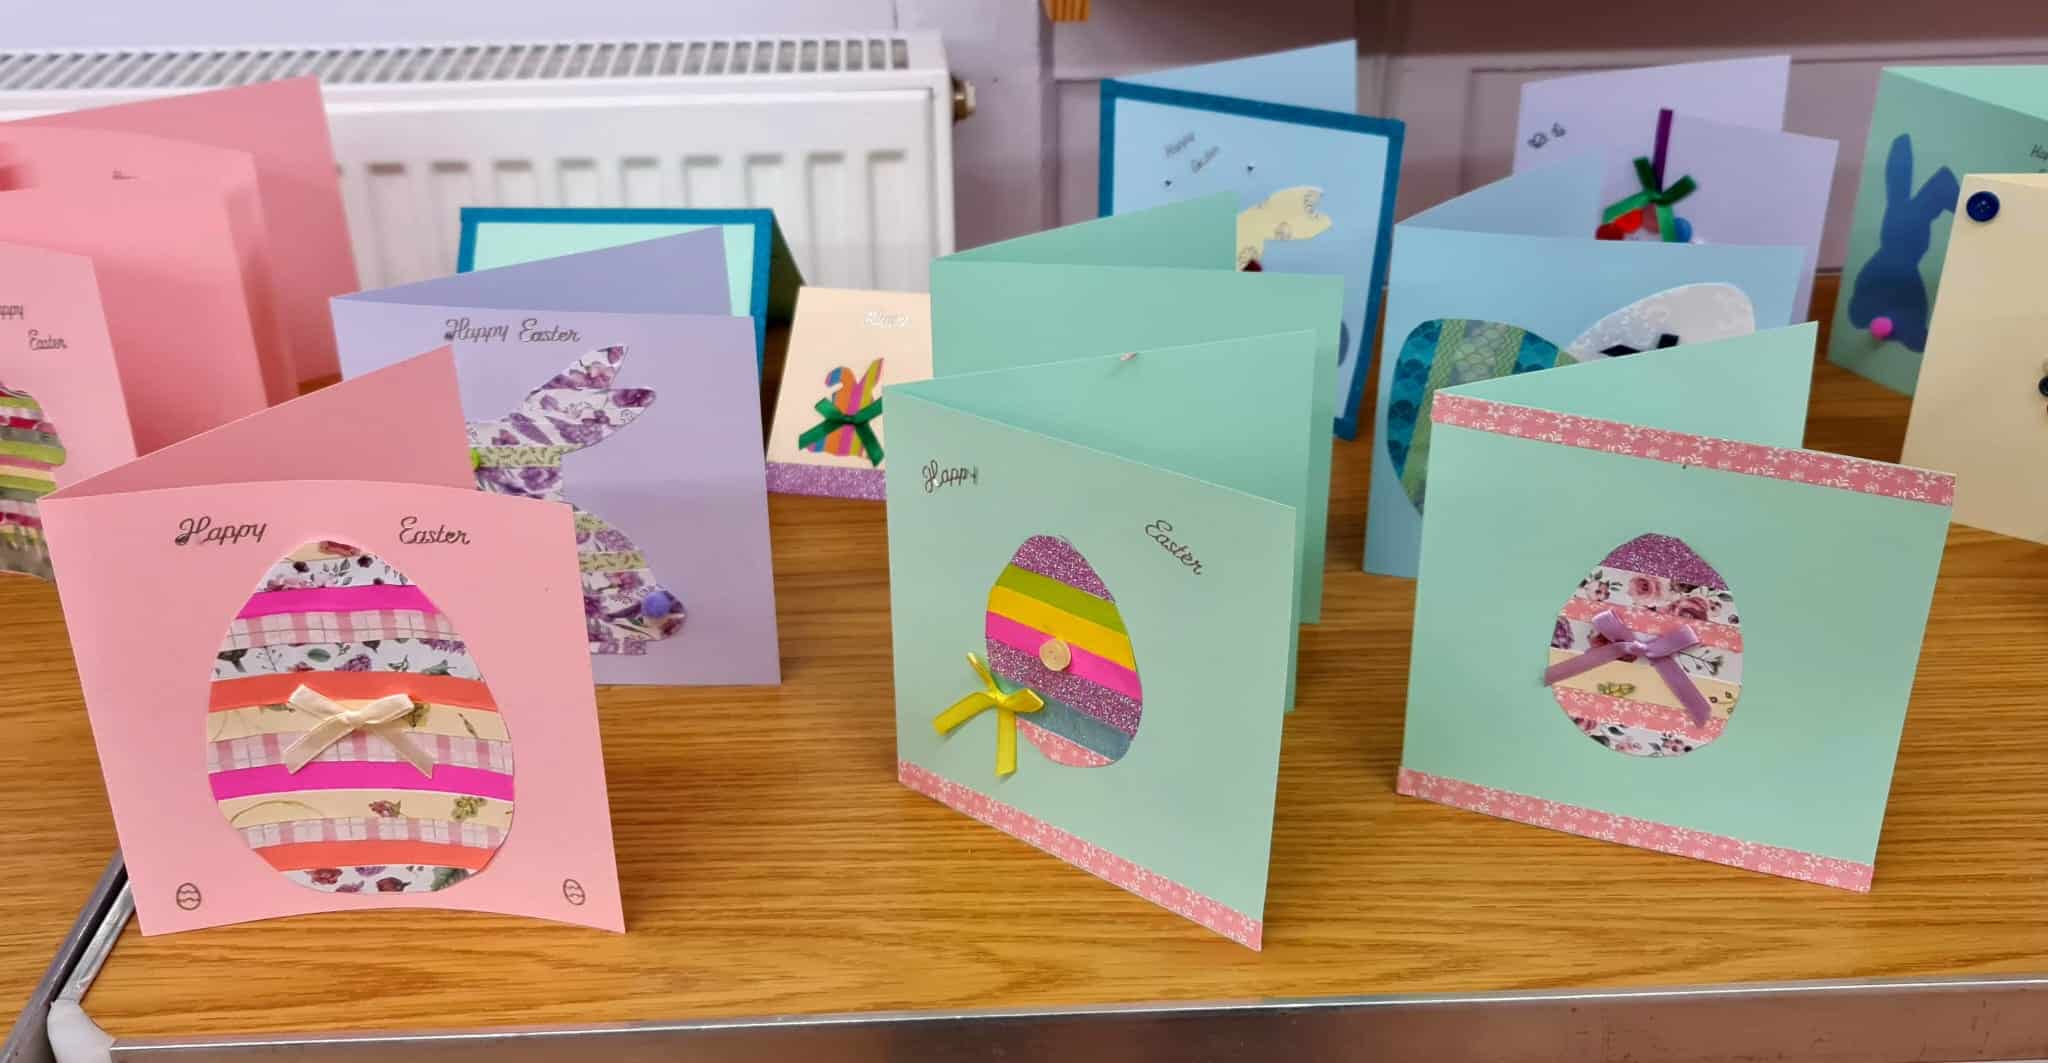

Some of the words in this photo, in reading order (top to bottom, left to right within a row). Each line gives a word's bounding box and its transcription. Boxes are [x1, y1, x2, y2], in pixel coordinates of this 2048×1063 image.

[444, 317, 510, 343] Happy
[518, 317, 581, 343] Easter
[174, 516, 268, 546] Happy
[398, 516, 472, 545] Easter
[1144, 519, 1203, 576] Easter
